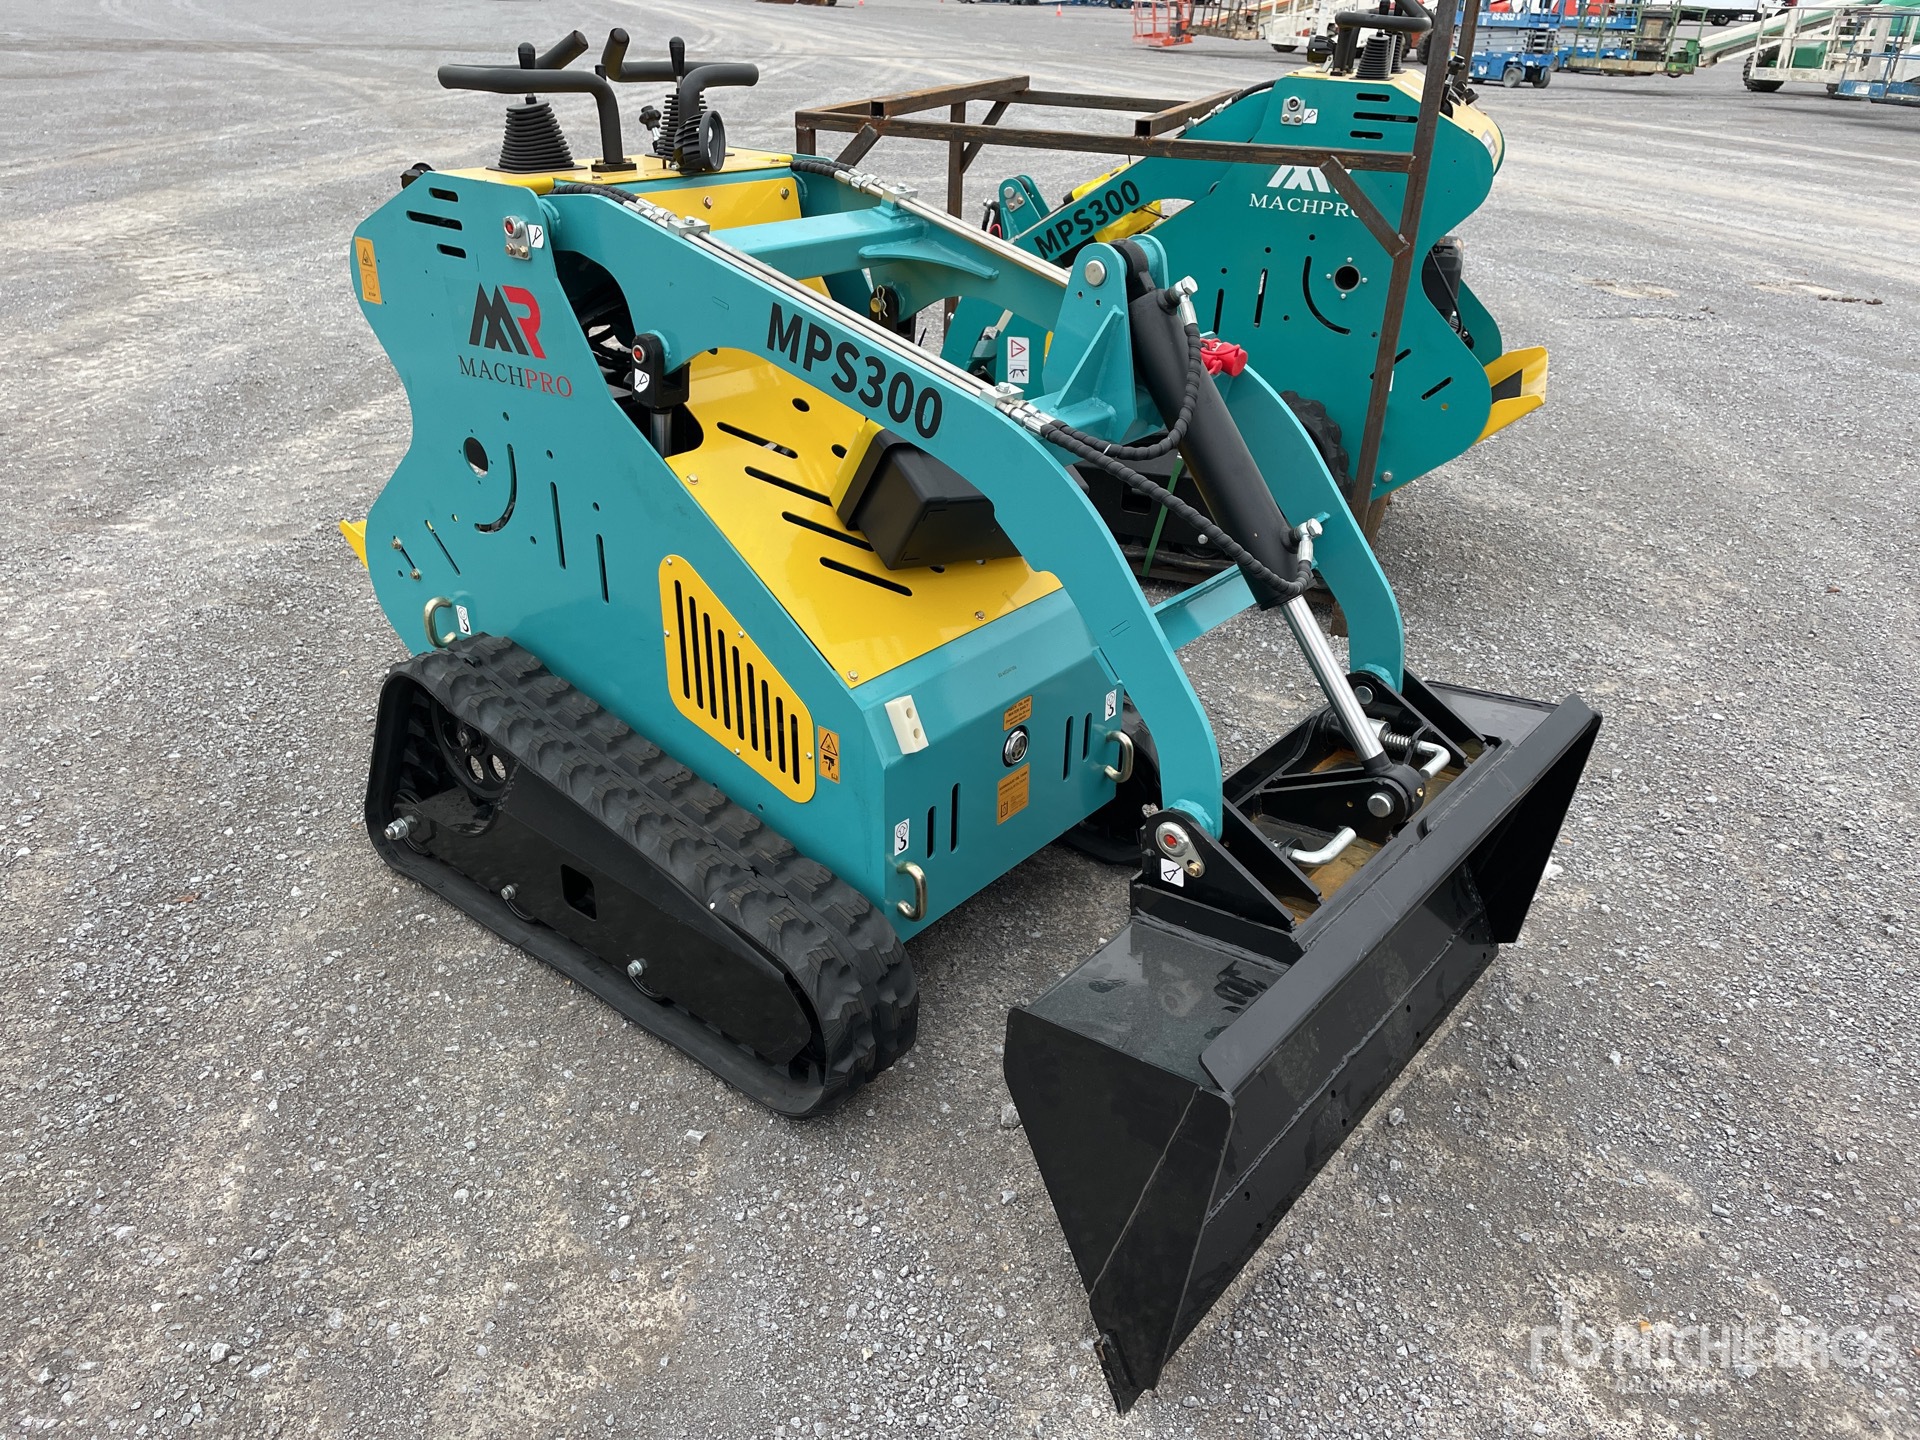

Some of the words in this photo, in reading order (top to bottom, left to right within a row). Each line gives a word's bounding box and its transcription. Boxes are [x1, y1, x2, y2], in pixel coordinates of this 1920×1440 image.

[1033, 180, 1140, 260] MPS300
[458, 354, 573, 398] MACHPRO
[766, 301, 943, 439] MPS300
